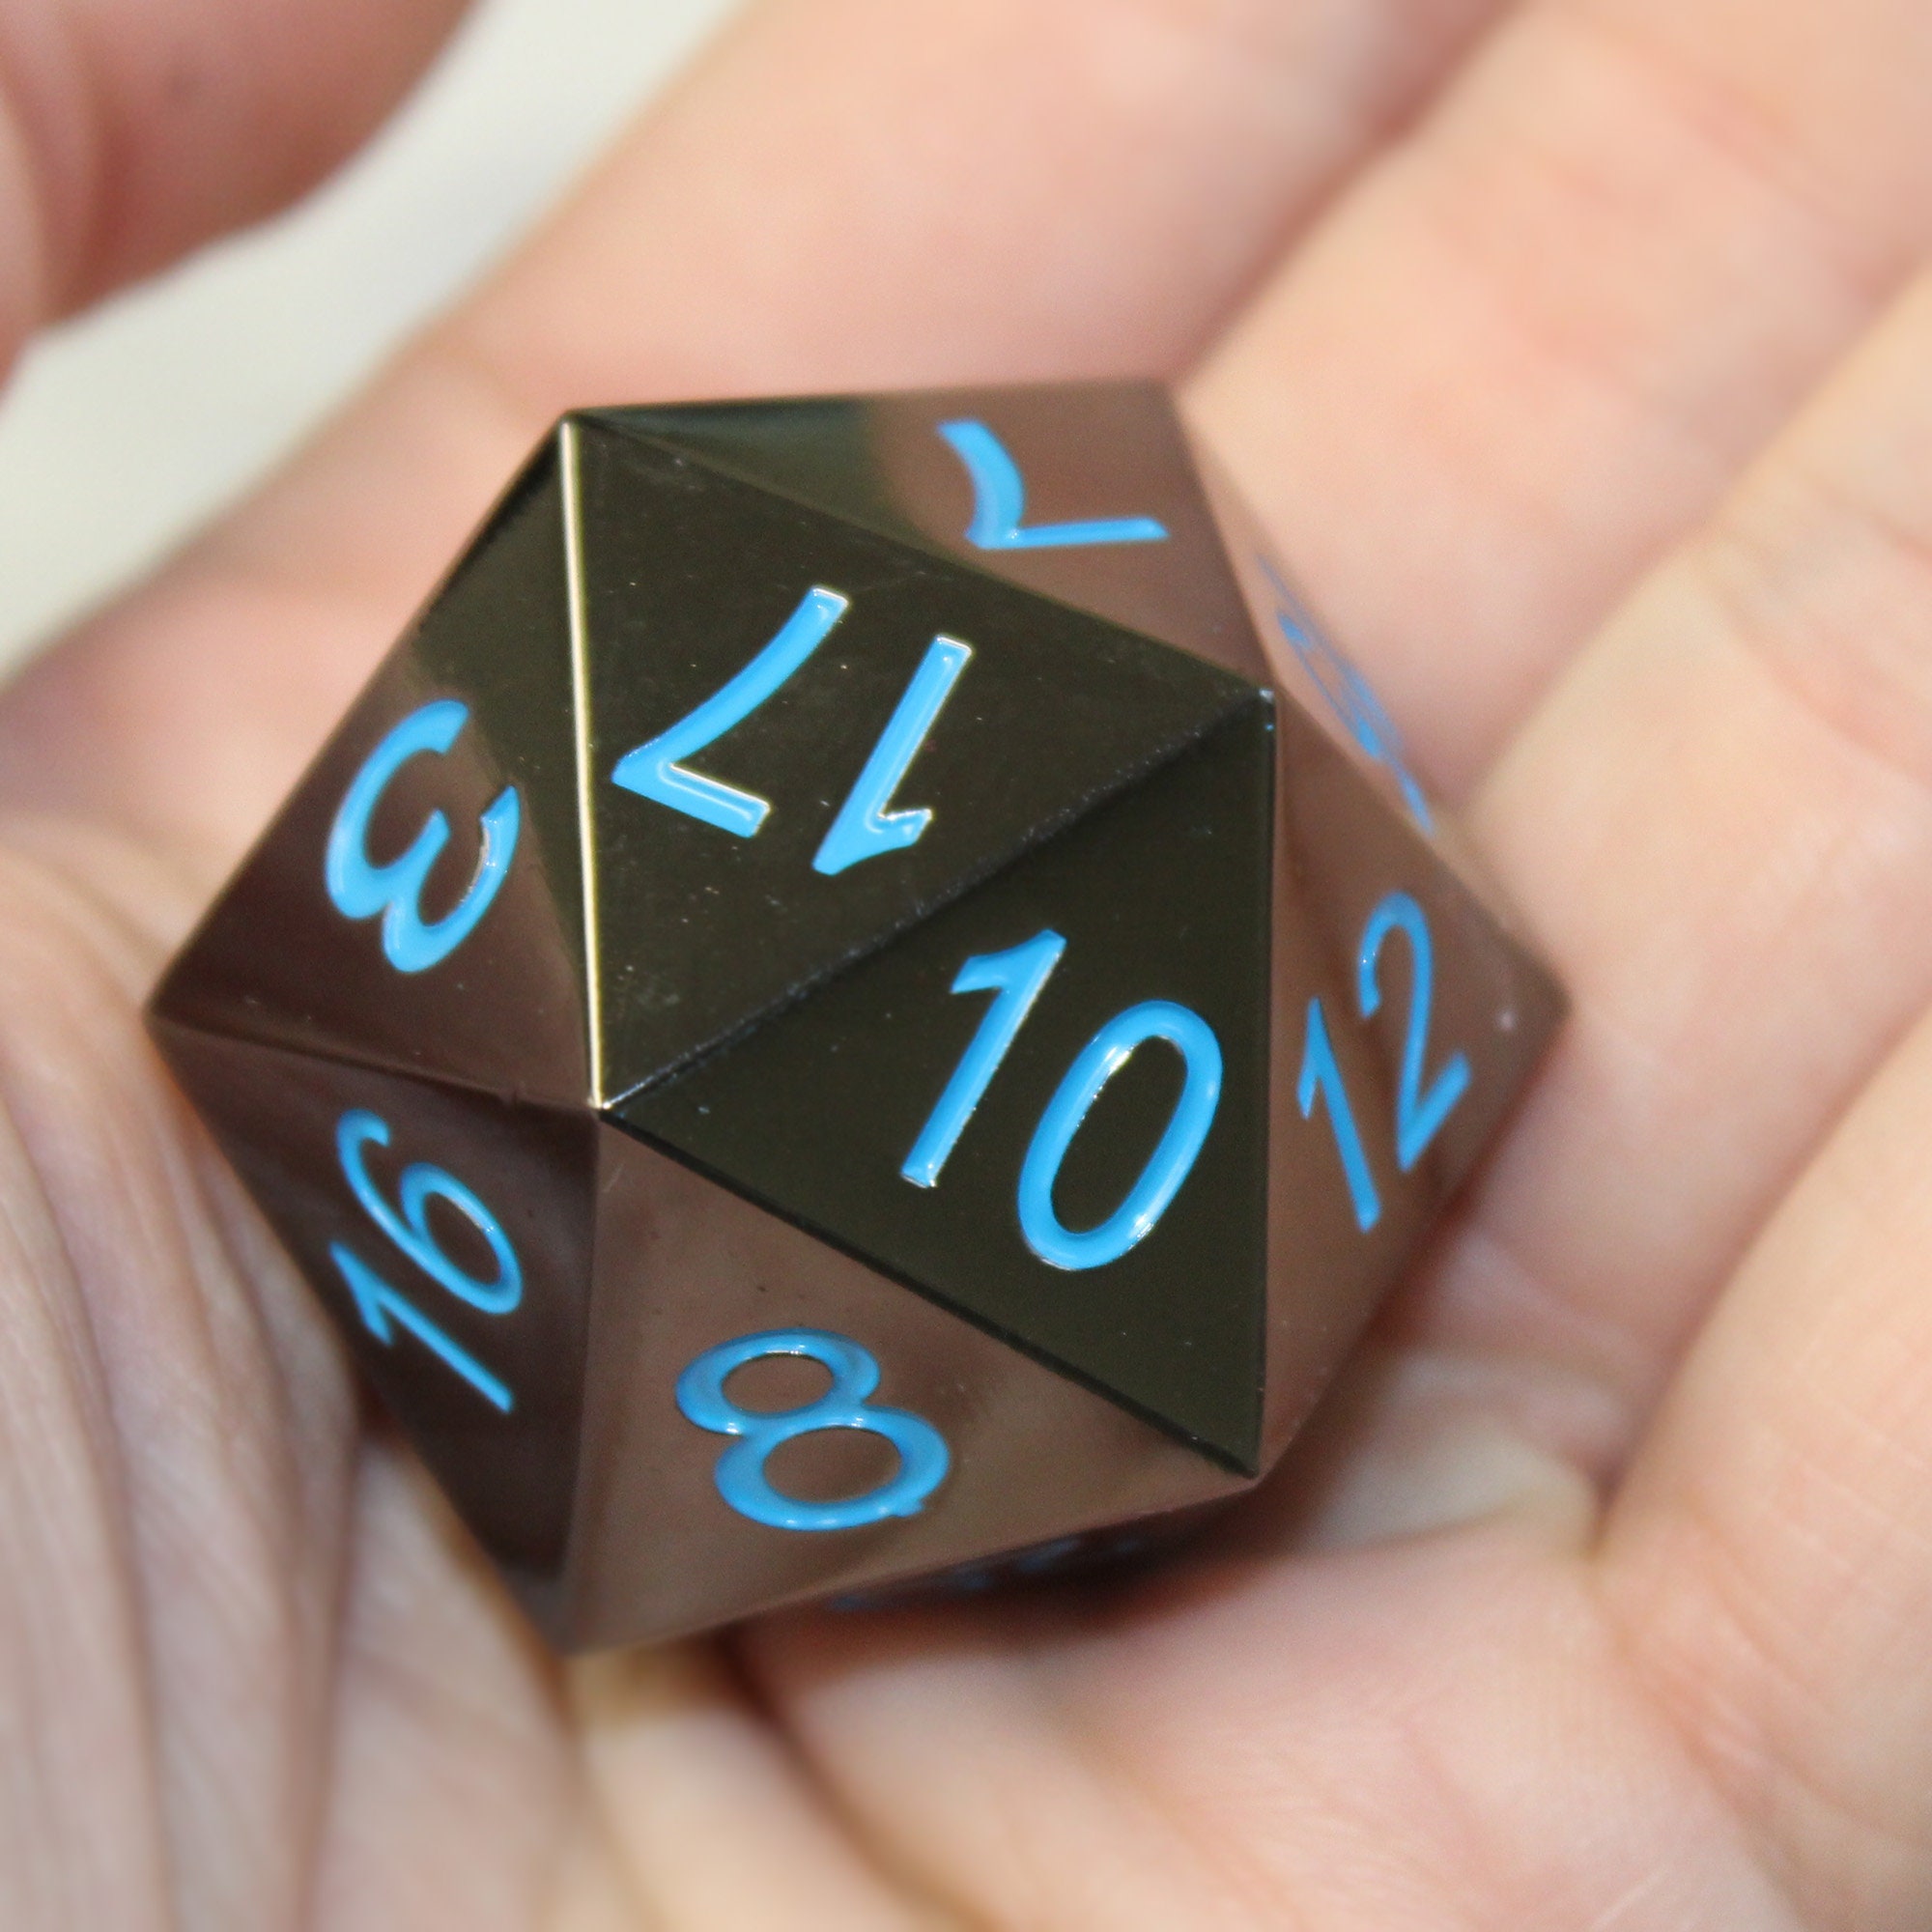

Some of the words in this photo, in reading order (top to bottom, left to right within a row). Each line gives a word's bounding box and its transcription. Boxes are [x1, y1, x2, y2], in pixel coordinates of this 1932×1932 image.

[325, 699, 520, 973] 3
[611, 588, 972, 876] 17
[900, 928, 1224, 1271] 10
[1297, 894, 1470, 1231] 12
[329, 1109, 524, 1412] 16
[675, 1327, 951, 1532] 8
